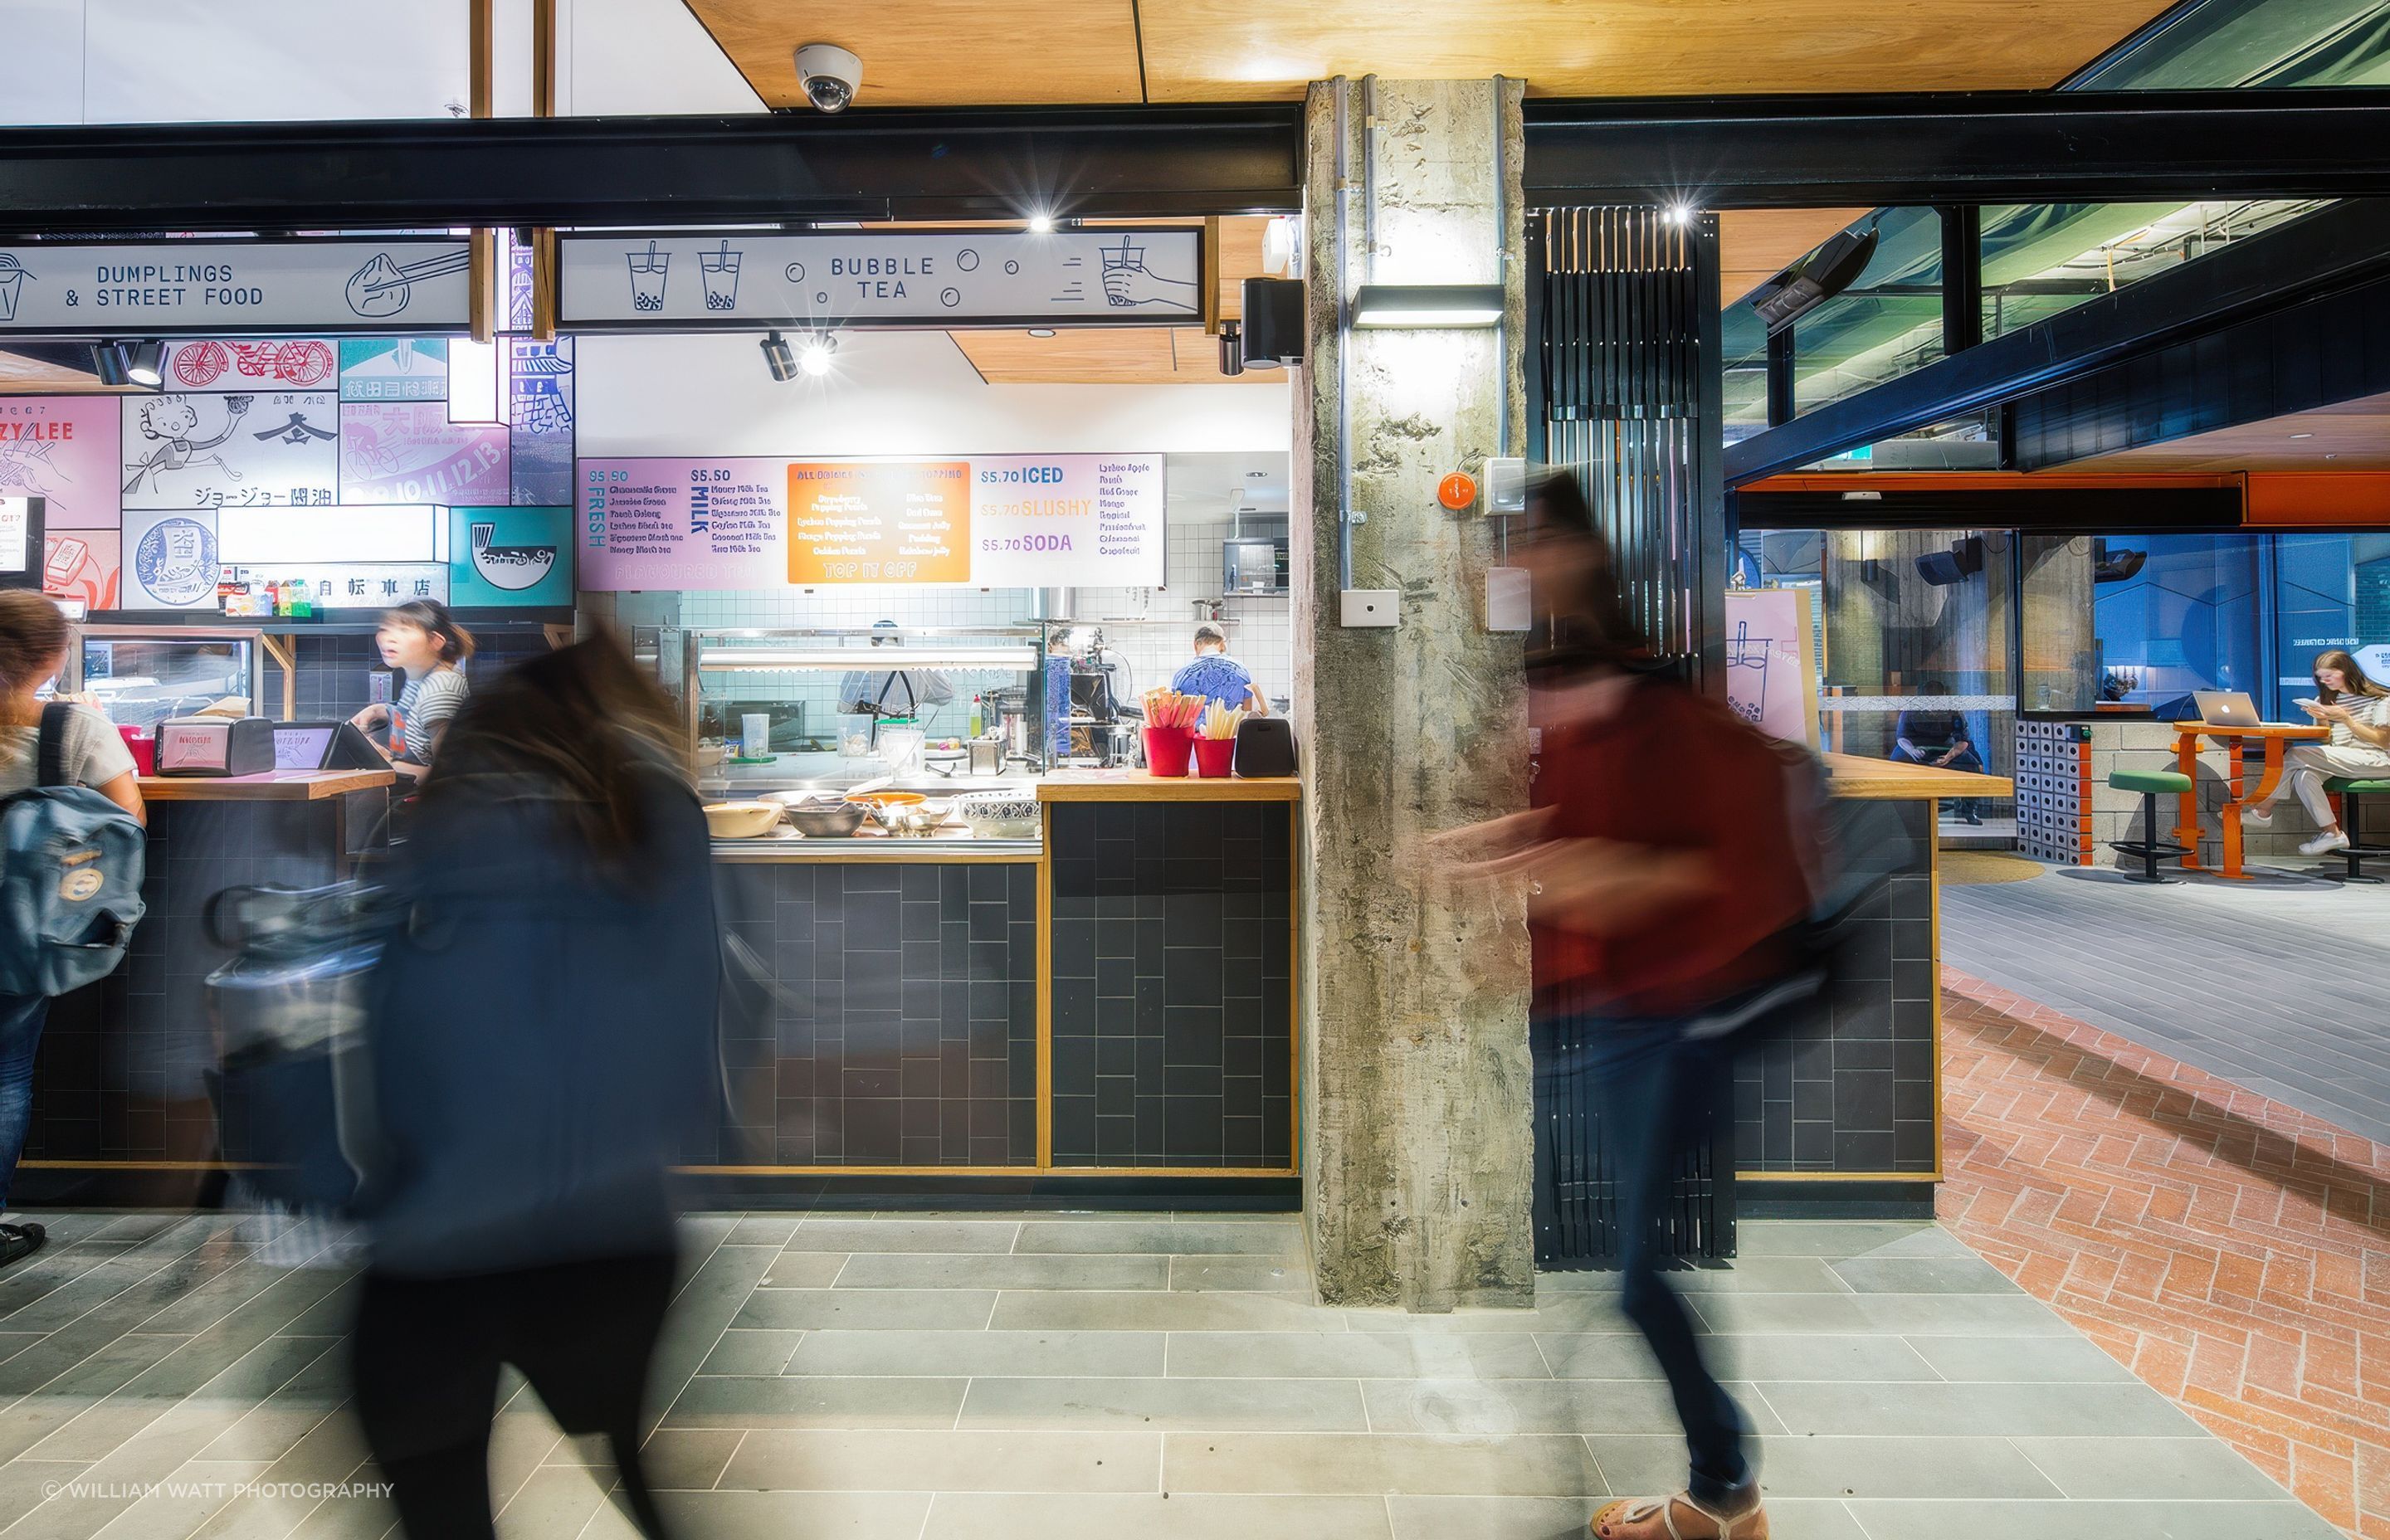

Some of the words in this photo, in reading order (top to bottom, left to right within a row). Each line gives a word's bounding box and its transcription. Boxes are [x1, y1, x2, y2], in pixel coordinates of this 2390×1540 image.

[97, 265, 232, 283] DUMPLINGS
[832, 258, 934, 275] BUBBLE
[66, 290, 79, 306] &
[97, 288, 187, 306] STREET
[205, 288, 263, 305] FOOD
[857, 280, 906, 298] TEA
[36, 422, 72, 440] LEE
[1022, 467, 1063, 483] ICED
[588, 487, 606, 548] FRESH
[690, 486, 709, 534] MILK
[1022, 500, 1092, 517] SLUSHY
[1023, 534, 1072, 552] SODA
